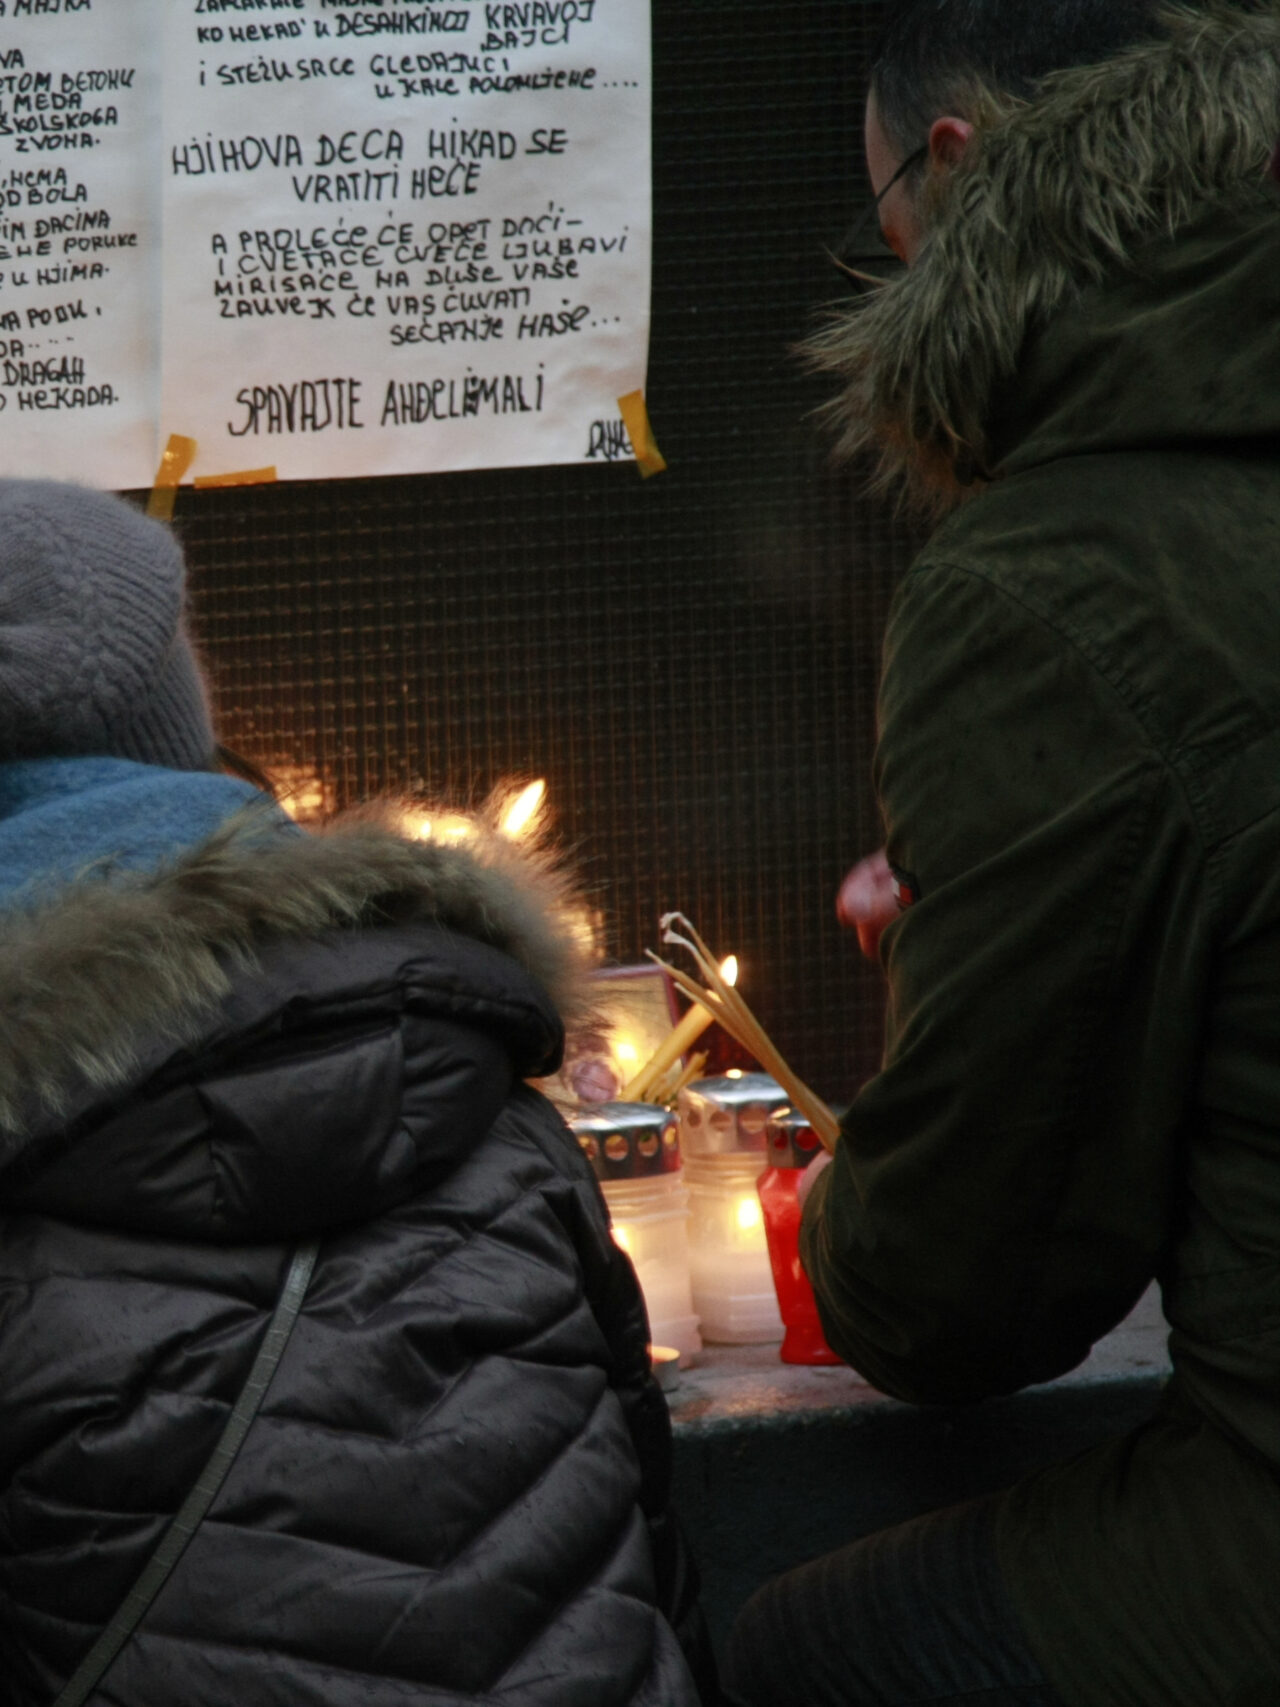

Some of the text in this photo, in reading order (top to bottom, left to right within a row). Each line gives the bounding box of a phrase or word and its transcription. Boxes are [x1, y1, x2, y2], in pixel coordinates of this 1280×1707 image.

[315, 128, 404, 167] DECA
[524, 129, 569, 155] SE
[27, 183, 88, 206] BOLA
[212, 233, 228, 254] A
[386, 294, 436, 316] VAS
